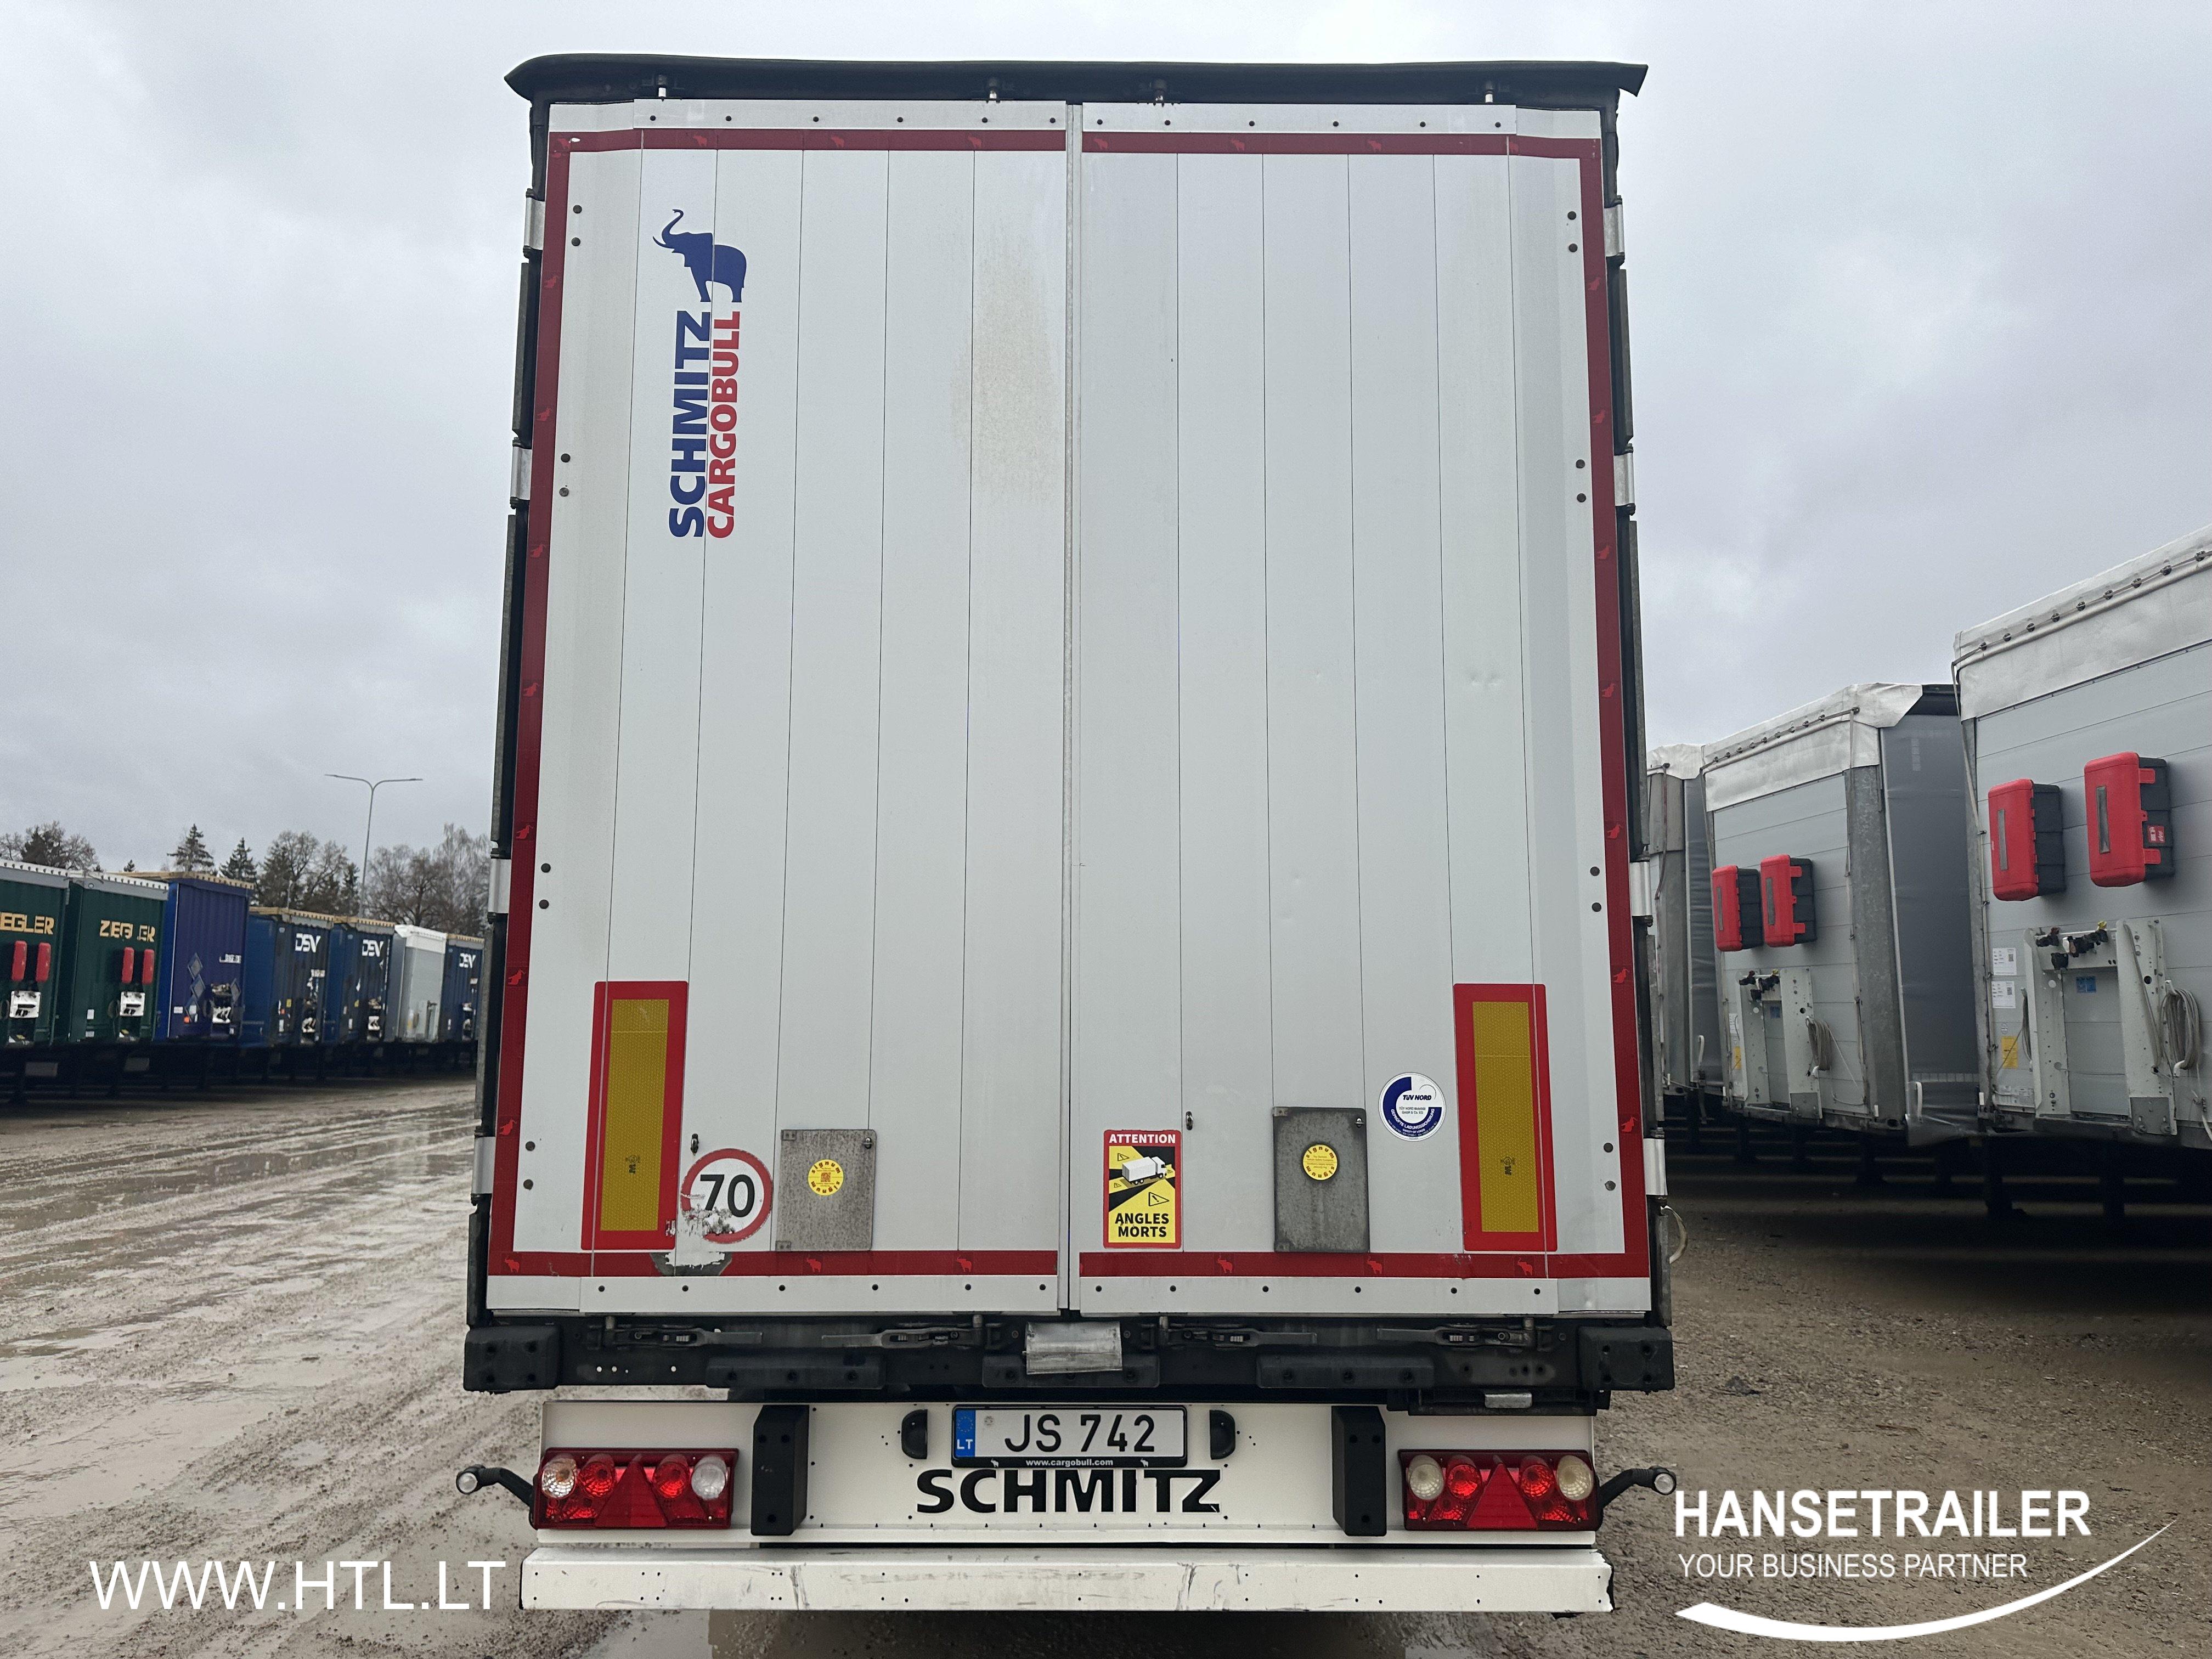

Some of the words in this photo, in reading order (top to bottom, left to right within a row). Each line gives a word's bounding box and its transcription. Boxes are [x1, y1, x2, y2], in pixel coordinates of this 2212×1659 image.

[669, 311, 710, 538] SCHMITZ
[707, 311, 741, 539] CARGOBULL
[0, 911, 54, 935] EGLER
[295, 933, 321, 953] DSV
[362, 939, 384, 957] DSV
[459, 952, 476, 969] DSV
[1109, 1133, 1176, 1144] ATTENTION
[699, 1173, 755, 1218] 70
[1115, 1212, 1170, 1224] ANGLES
[1118, 1226, 1167, 1238] MORTS
[1005, 1414, 1062, 1452] JS
[1080, 1414, 1155, 1452] 742
[956, 1438, 973, 1450] LT
[1025, 1458, 1114, 1468] www.cargobull.com
[916, 1469, 1221, 1514] SCHMITZ
